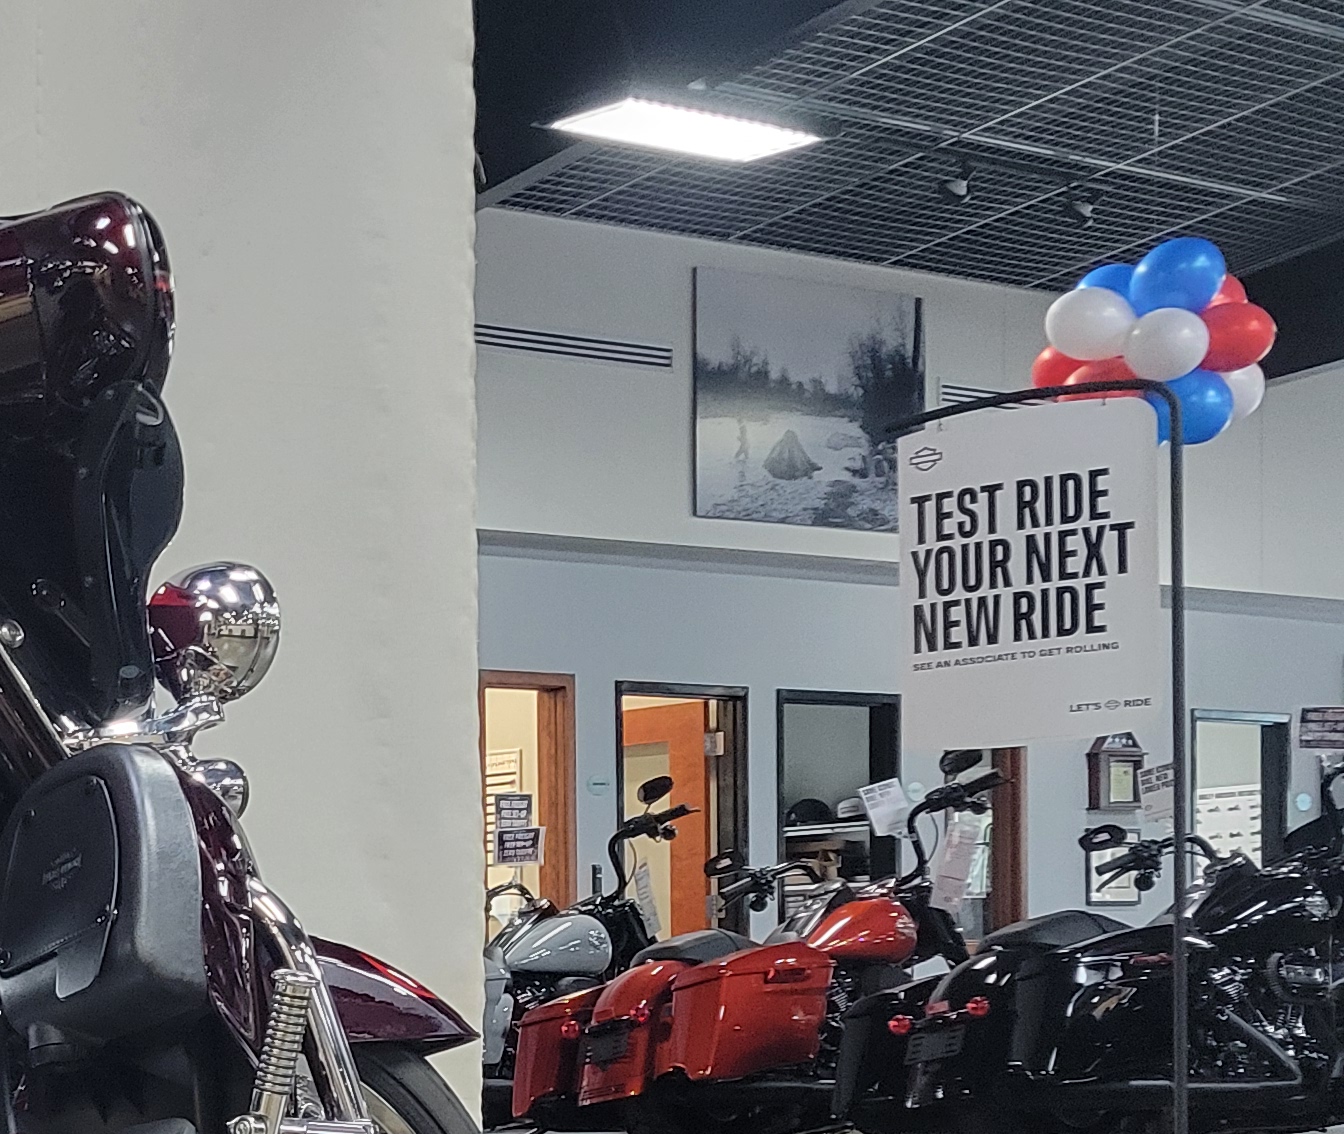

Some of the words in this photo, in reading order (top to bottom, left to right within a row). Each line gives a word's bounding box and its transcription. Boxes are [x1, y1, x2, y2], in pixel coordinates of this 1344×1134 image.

[910, 482, 1004, 546] TEST
[1016, 467, 1111, 531] RIDE
[911, 538, 1012, 599] YOUR
[1025, 521, 1135, 584] NEXT
[913, 594, 1002, 654] NEW
[1012, 581, 1107, 642] RIDE
[912, 662, 934, 671] SEE
[935, 660, 952, 669] AN
[954, 652, 1018, 667] ASSOCIATE
[1020, 650, 1037, 659] TO
[1039, 647, 1062, 658] GET
[1065, 641, 1120, 654] ROLLING
[1069, 702, 1103, 713] LET'S
[1123, 698, 1152, 708] RIDE
